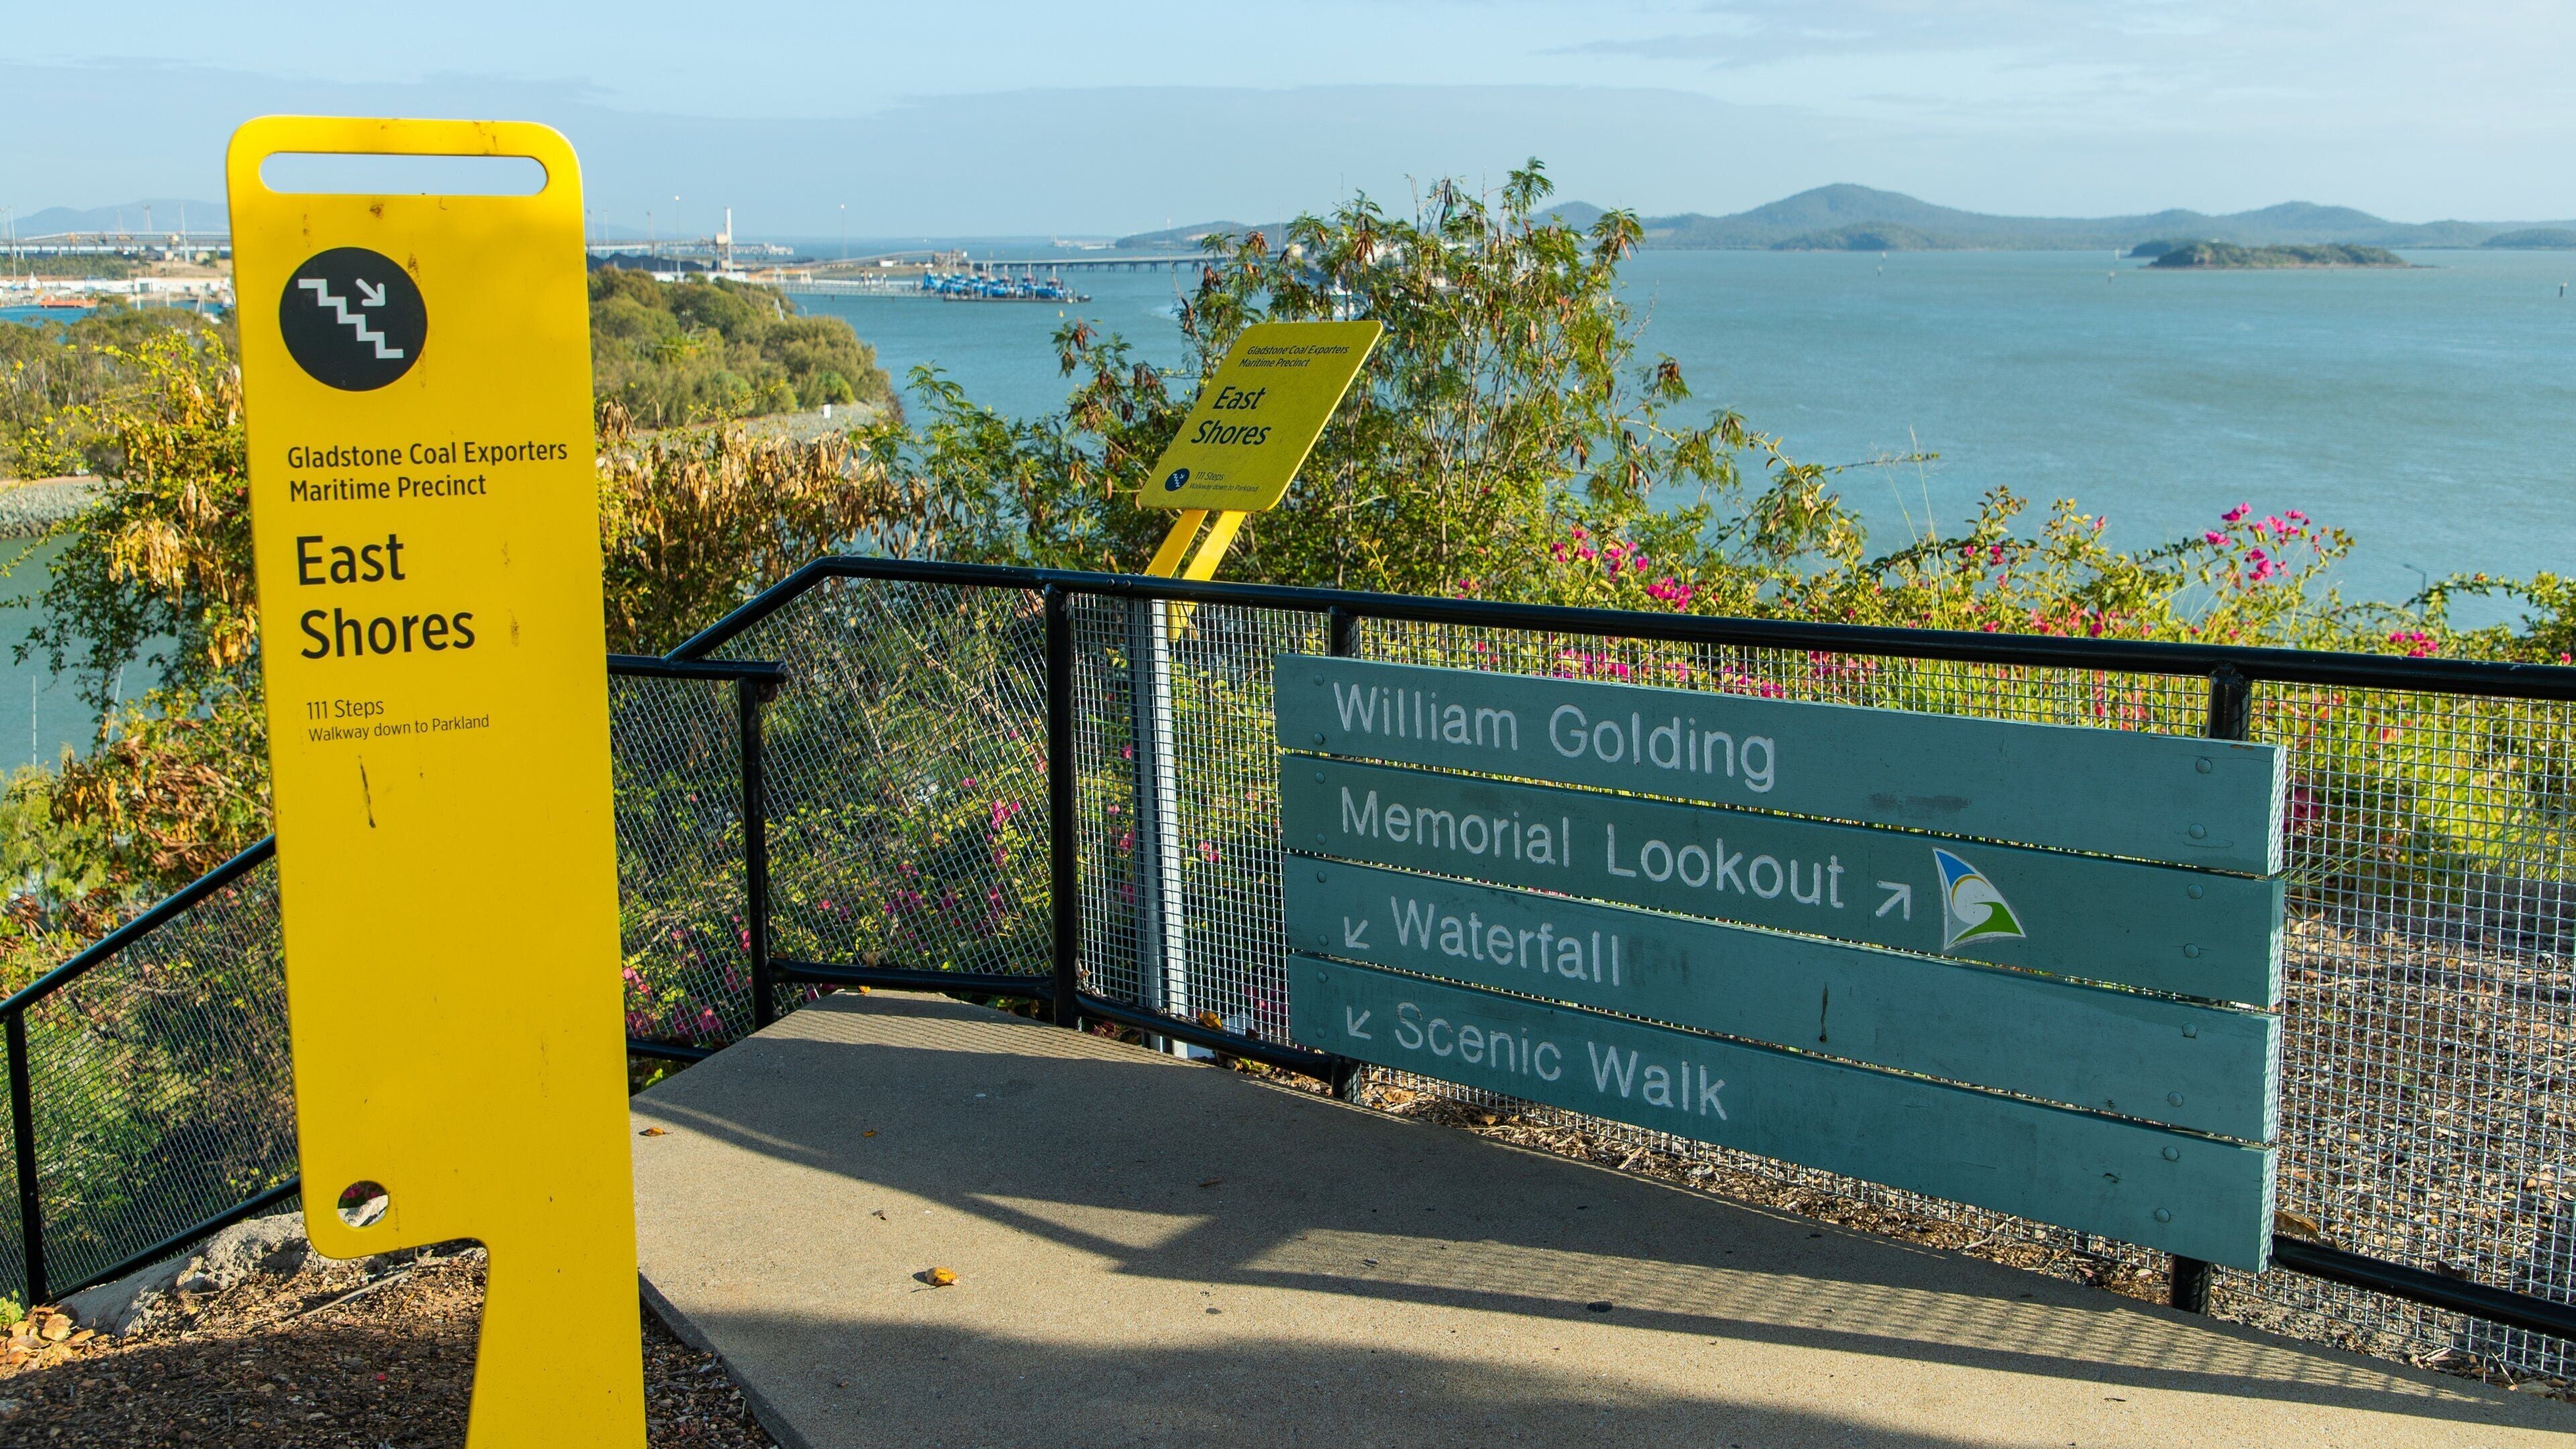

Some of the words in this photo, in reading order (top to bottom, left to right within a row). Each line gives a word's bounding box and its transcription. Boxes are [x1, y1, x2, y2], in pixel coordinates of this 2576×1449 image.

[1240, 358, 1275, 368] Maritime
[1276, 358, 1310, 367] Precinct
[1247, 345, 1288, 355] Gladstone
[1289, 345, 1308, 355] Coal
[1309, 345, 1349, 356] Exporters
[1212, 386, 1266, 410] East
[1191, 420, 1272, 445] Shores
[287, 445, 403, 469] Gladstone
[409, 441, 458, 465] Coal
[464, 440, 568, 466] Exporters
[290, 478, 390, 502] Maritime
[397, 474, 486, 498] Precinct
[1189, 483, 1212, 491] Walkway
[1234, 484, 1259, 492] Parkland
[1195, 472, 1205, 480] 111
[1205, 472, 1225, 482] Steps
[296, 533, 406, 586] East
[301, 608, 476, 659] Shores
[307, 701, 329, 720] 111
[334, 699, 385, 719] Steps
[309, 725, 370, 742] Walkway
[374, 722, 411, 737] down
[415, 720, 429, 733] to
[433, 714, 490, 731] Parkland
[1333, 682, 1519, 751] William
[1549, 704, 1776, 794] Golding
[1342, 786, 1570, 867] Memorial
[1607, 822, 1845, 909] Lookout
[1391, 896, 1621, 987] Waterfall
[1396, 1002, 1562, 1081] Scenic
[1589, 1041, 1728, 1120] Walk
